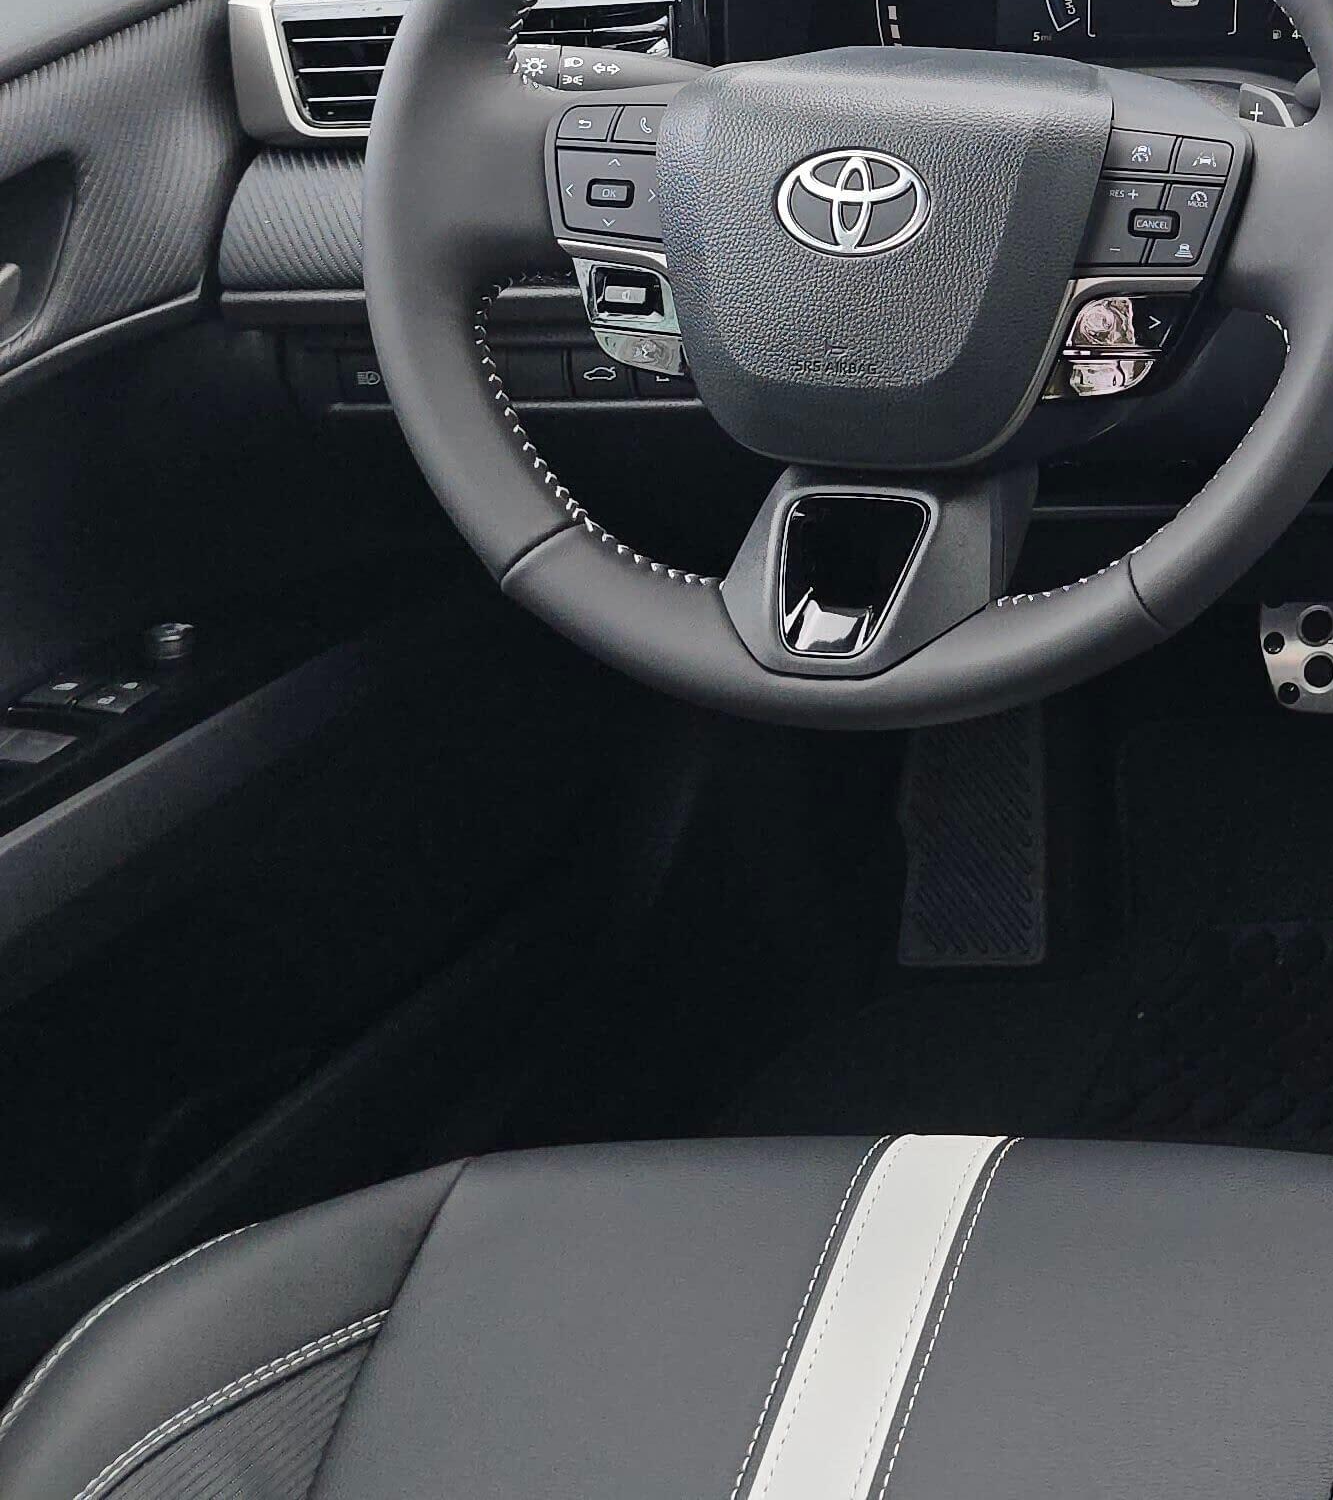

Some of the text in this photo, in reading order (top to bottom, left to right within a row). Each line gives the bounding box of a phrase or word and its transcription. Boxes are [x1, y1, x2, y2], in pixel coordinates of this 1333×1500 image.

[602, 189, 617, 198] OK
[1109, 189, 1125, 198] RES
[1135, 219, 1169, 230] CANCEL
